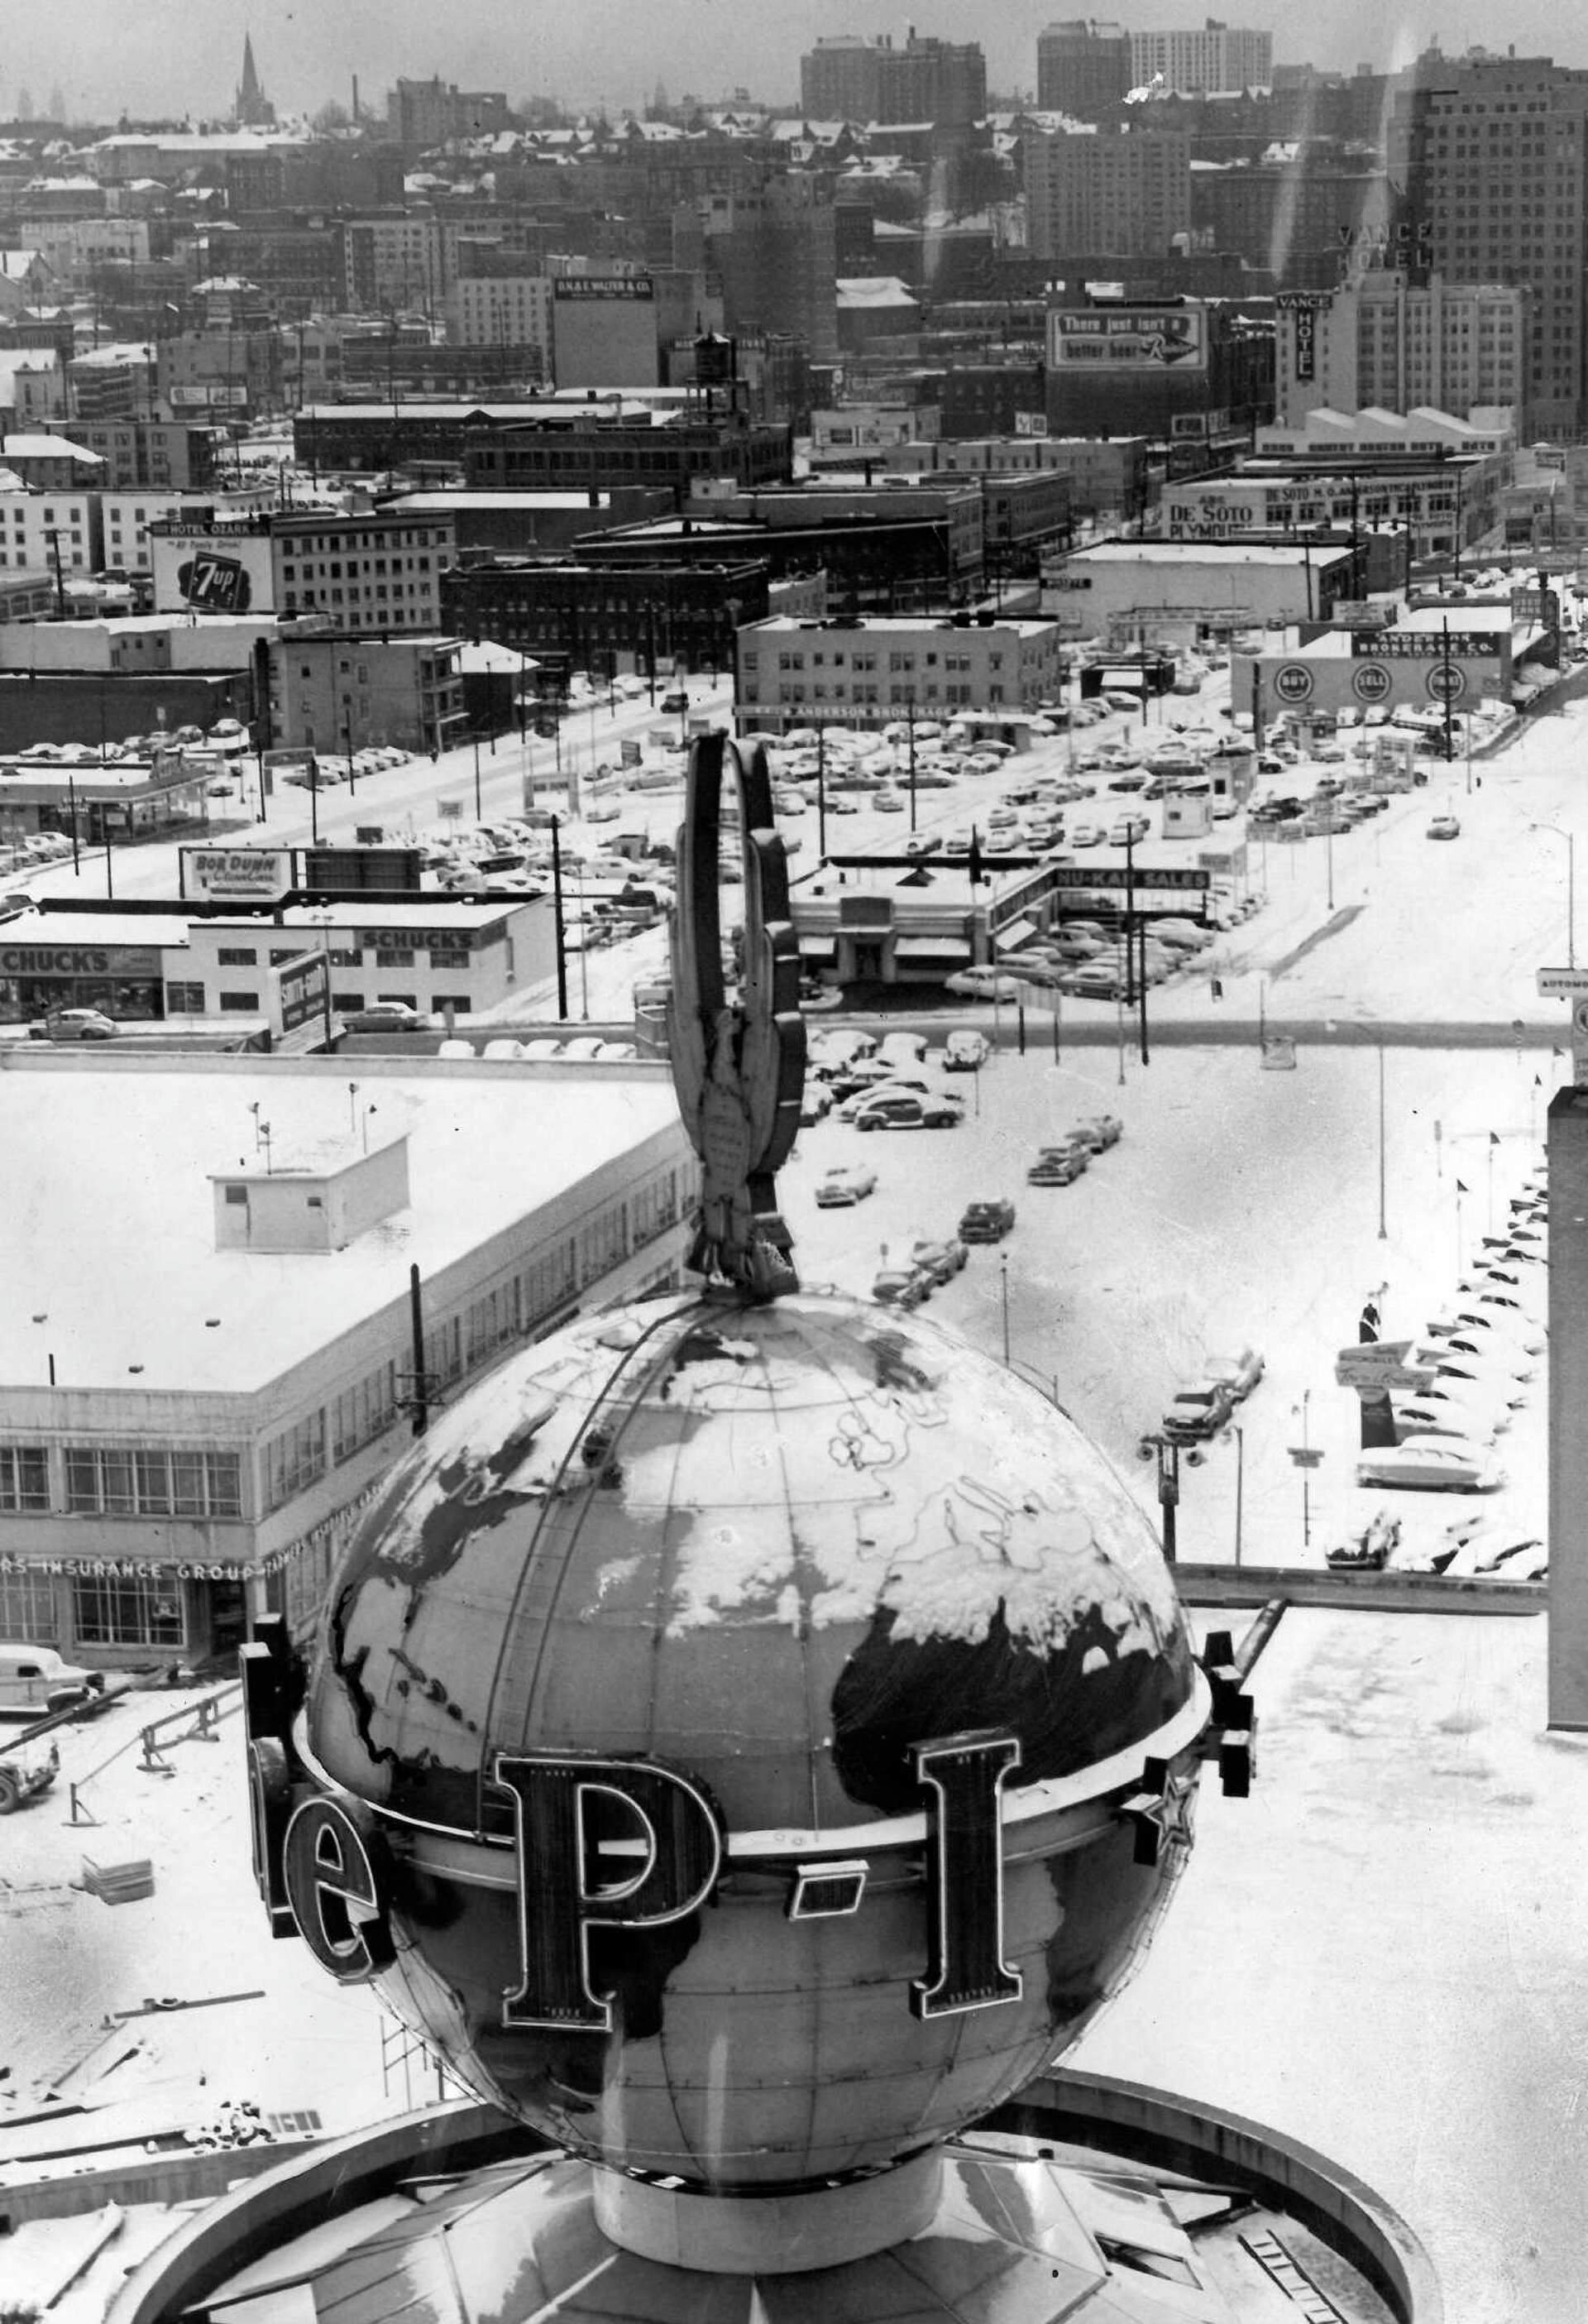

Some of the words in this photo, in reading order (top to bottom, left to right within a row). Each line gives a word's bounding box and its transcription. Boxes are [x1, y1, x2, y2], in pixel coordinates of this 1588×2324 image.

[1339, 222, 1433, 246] VANCE
[1337, 249, 1434, 271] HOTEL
[1279, 297, 1330, 308] VANCE
[1299, 313, 1312, 375] HOTEL
[1170, 505, 1195, 522] DE
[1203, 505, 1252, 522] SOTO
[170, 525, 206, 535] HOTEL
[211, 524, 249, 535] OZARK
[1359, 643, 1459, 653] BROKERAGE
[1359, 675, 1384, 686] SELL
[1144, 871, 1207, 888] SALES
[43, 1560, 161, 1579] INSURANCE
[177, 1564, 255, 1581] GROUP
